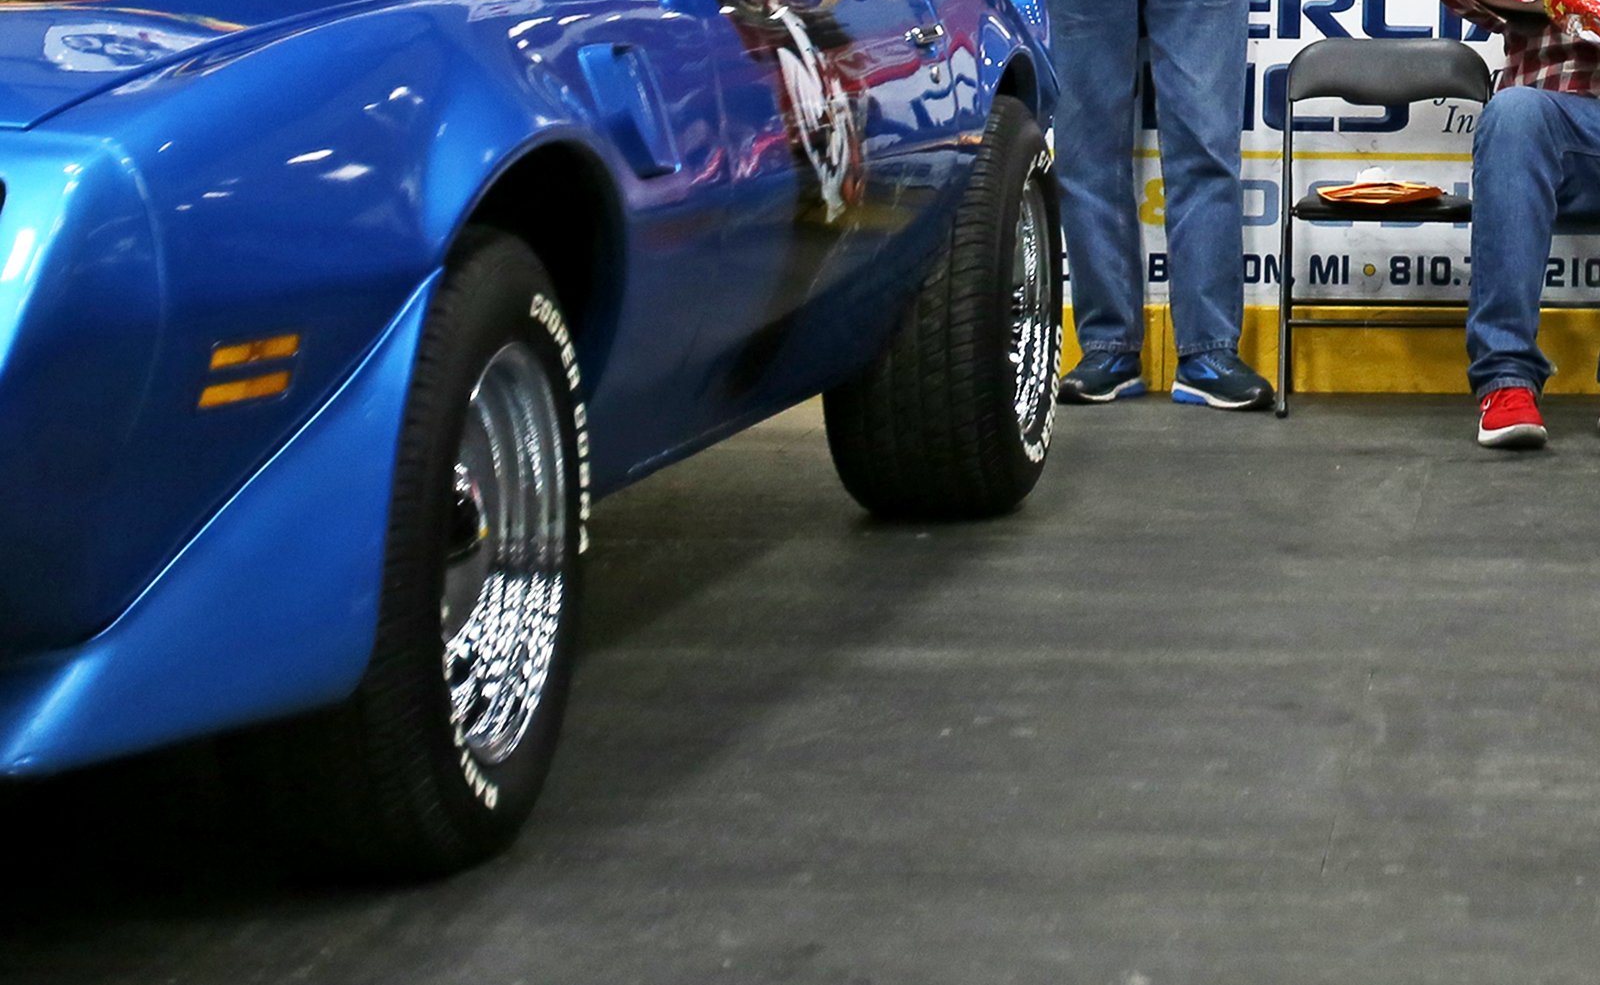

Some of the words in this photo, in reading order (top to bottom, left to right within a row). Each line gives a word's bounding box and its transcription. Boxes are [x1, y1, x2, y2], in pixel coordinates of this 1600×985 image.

[1309, 254, 1350, 285] MI
[530, 293, 582, 392] COOPER
[573, 401, 592, 555] COBRA
